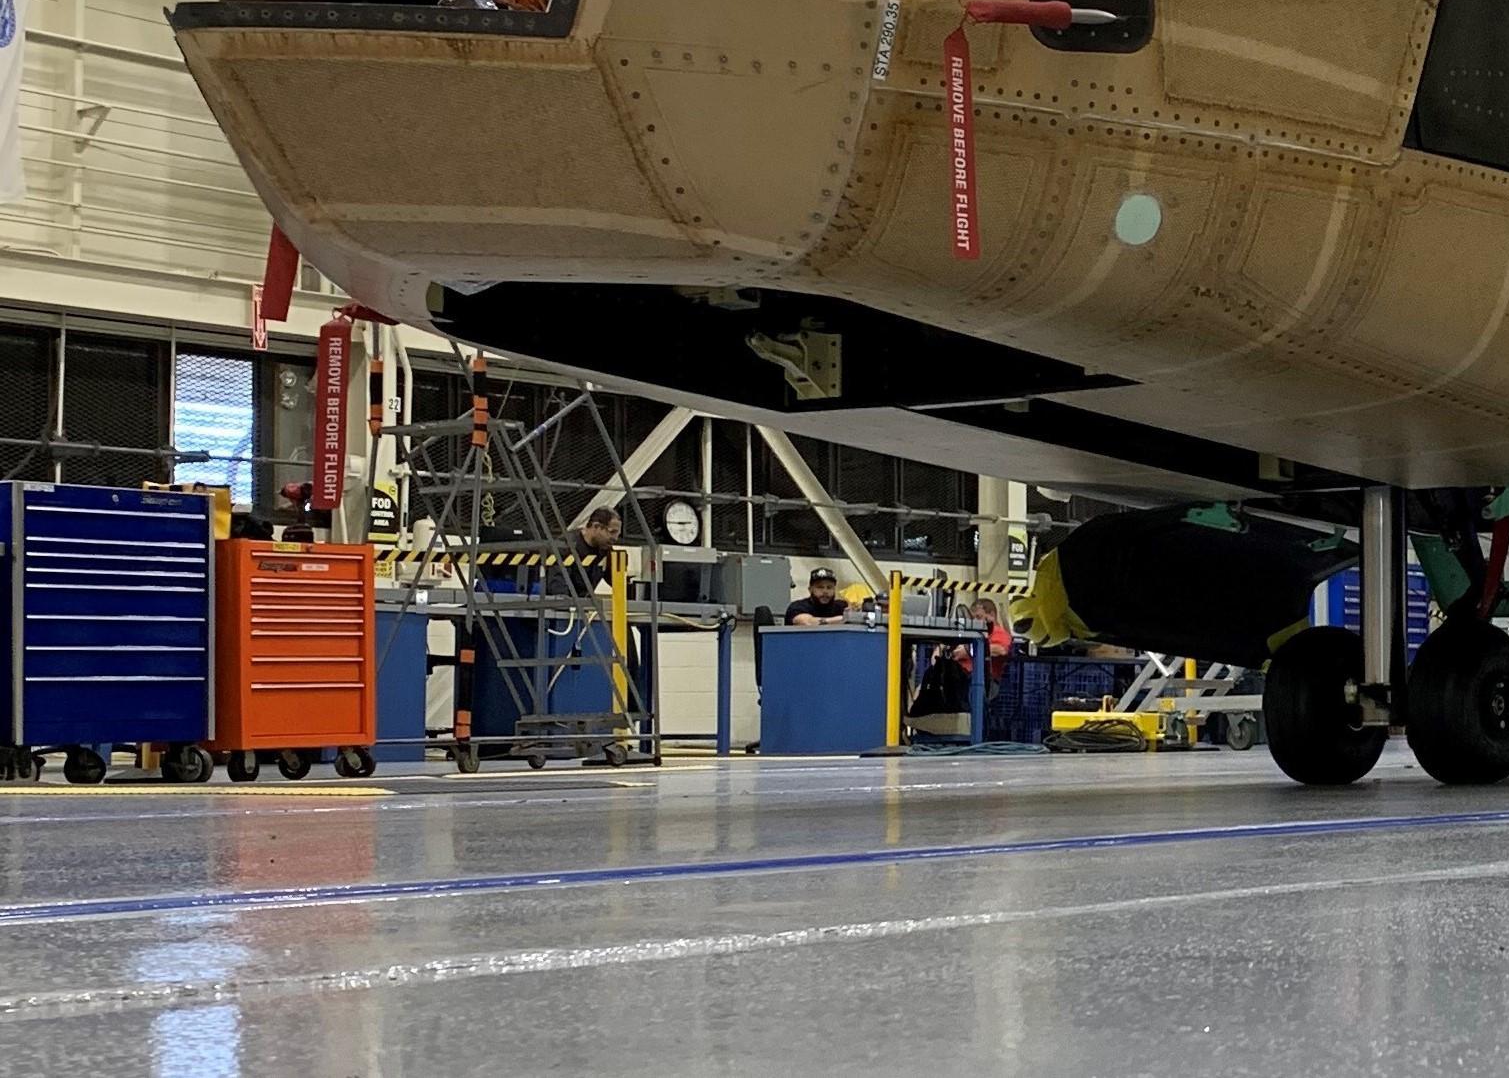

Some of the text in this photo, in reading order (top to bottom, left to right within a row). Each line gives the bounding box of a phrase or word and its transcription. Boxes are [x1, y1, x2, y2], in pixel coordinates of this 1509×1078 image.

[874, 2, 900, 77] STA 290.35
[952, 57, 970, 251] REMOVE BEFORE FLIGHT
[323, 337, 343, 501] REMOVE BEFORE FLIGHT
[388, 398, 400, 411] 22
[371, 497, 392, 509] FOD
